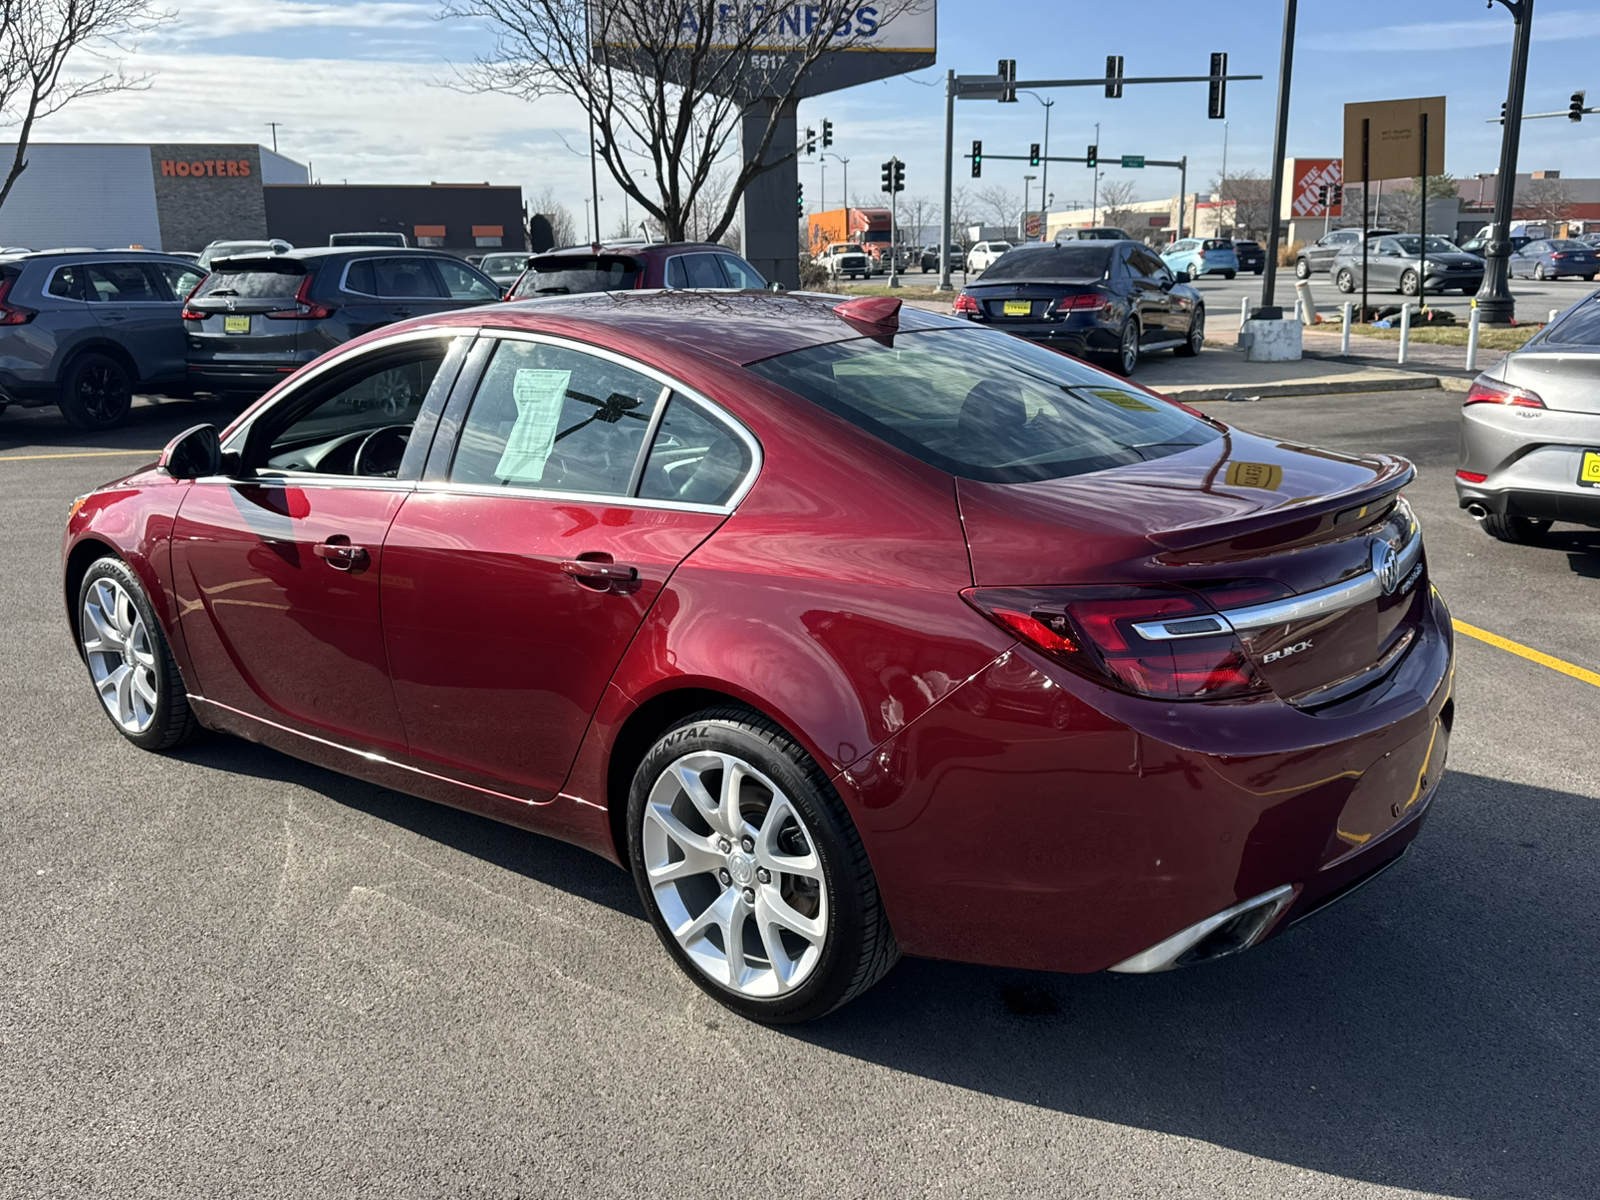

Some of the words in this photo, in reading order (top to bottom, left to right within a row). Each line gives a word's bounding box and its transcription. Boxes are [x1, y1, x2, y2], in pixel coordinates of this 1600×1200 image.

[161, 159, 251, 177] HOOTERS
[1298, 166, 1321, 189] THE
[1263, 639, 1314, 664] BUICK
